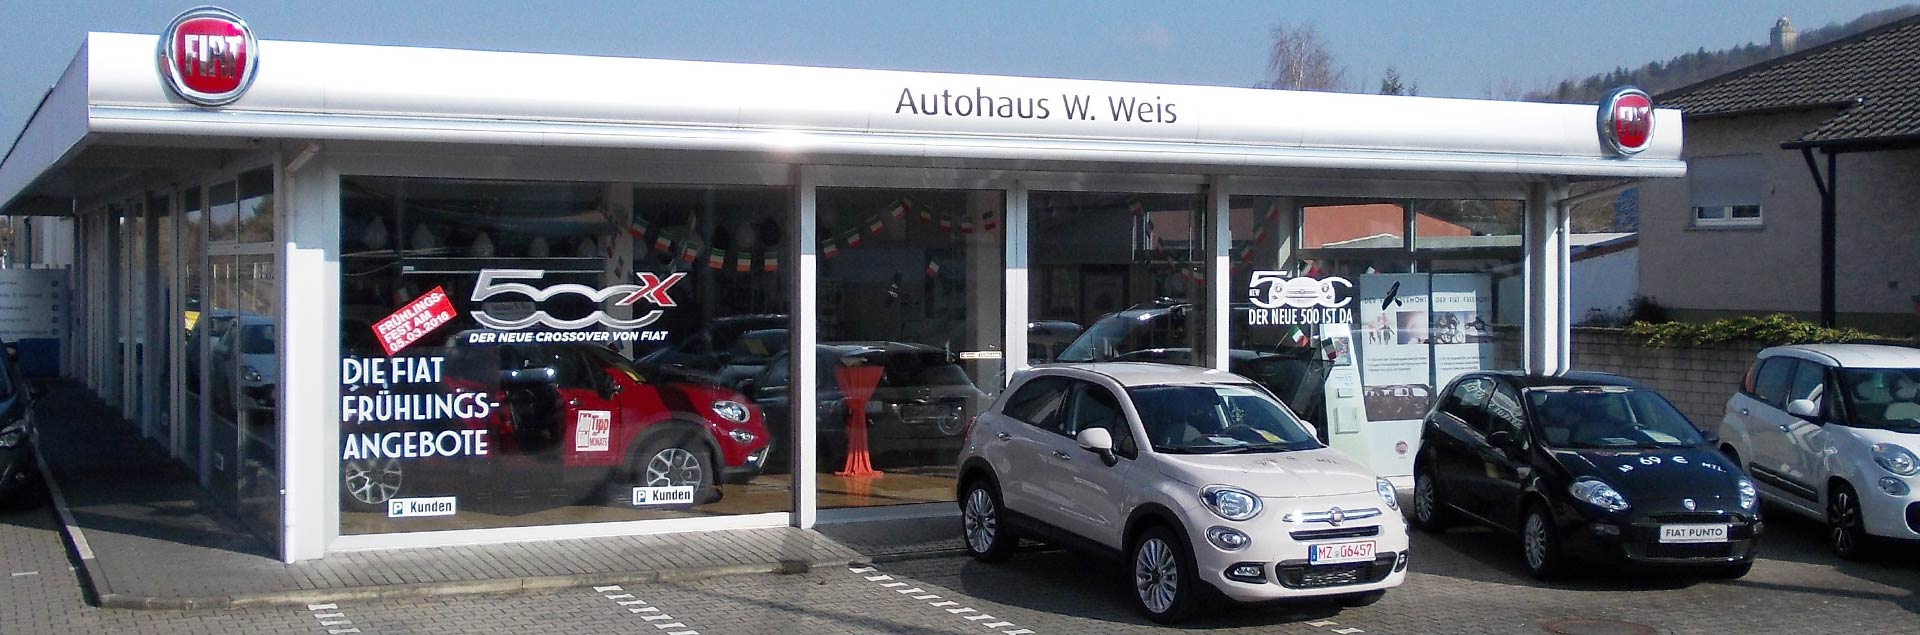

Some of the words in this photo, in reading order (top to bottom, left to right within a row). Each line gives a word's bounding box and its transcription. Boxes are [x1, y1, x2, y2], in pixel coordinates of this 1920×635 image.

[184, 34, 243, 78] FIAT
[895, 86, 1050, 120] Autohaus
[1062, 93, 1096, 121] W.
[1108, 96, 1177, 124] Weis
[377, 292, 446, 334] FRÜHLINGS-
[383, 321, 412, 344] FEST
[413, 309, 432, 327] AM
[1248, 308, 1269, 325] DER
[1271, 308, 1297, 325] NEUE
[1300, 308, 1320, 325] 500
[1322, 308, 1337, 324] IST
[1339, 307, 1353, 324] DA
[389, 310, 449, 352] 05.03.2016
[469, 333, 496, 343] DER
[498, 332, 533, 343] NEUE
[535, 331, 609, 342] CROSSOVER
[613, 331, 638, 341] VON
[640, 330, 668, 341] FIAT
[342, 357, 385, 385] DIE
[391, 357, 444, 384] FIAT
[342, 390, 500, 422] FRÜHLINGS-
[343, 430, 488, 460] ANGEBOTE
[410, 500, 452, 513] Kunden
[652, 489, 691, 501] Kunden
[1665, 529, 1686, 537] FIAT
[1689, 528, 1723, 537] PUNTO
[1319, 546, 1333, 559] MZ
